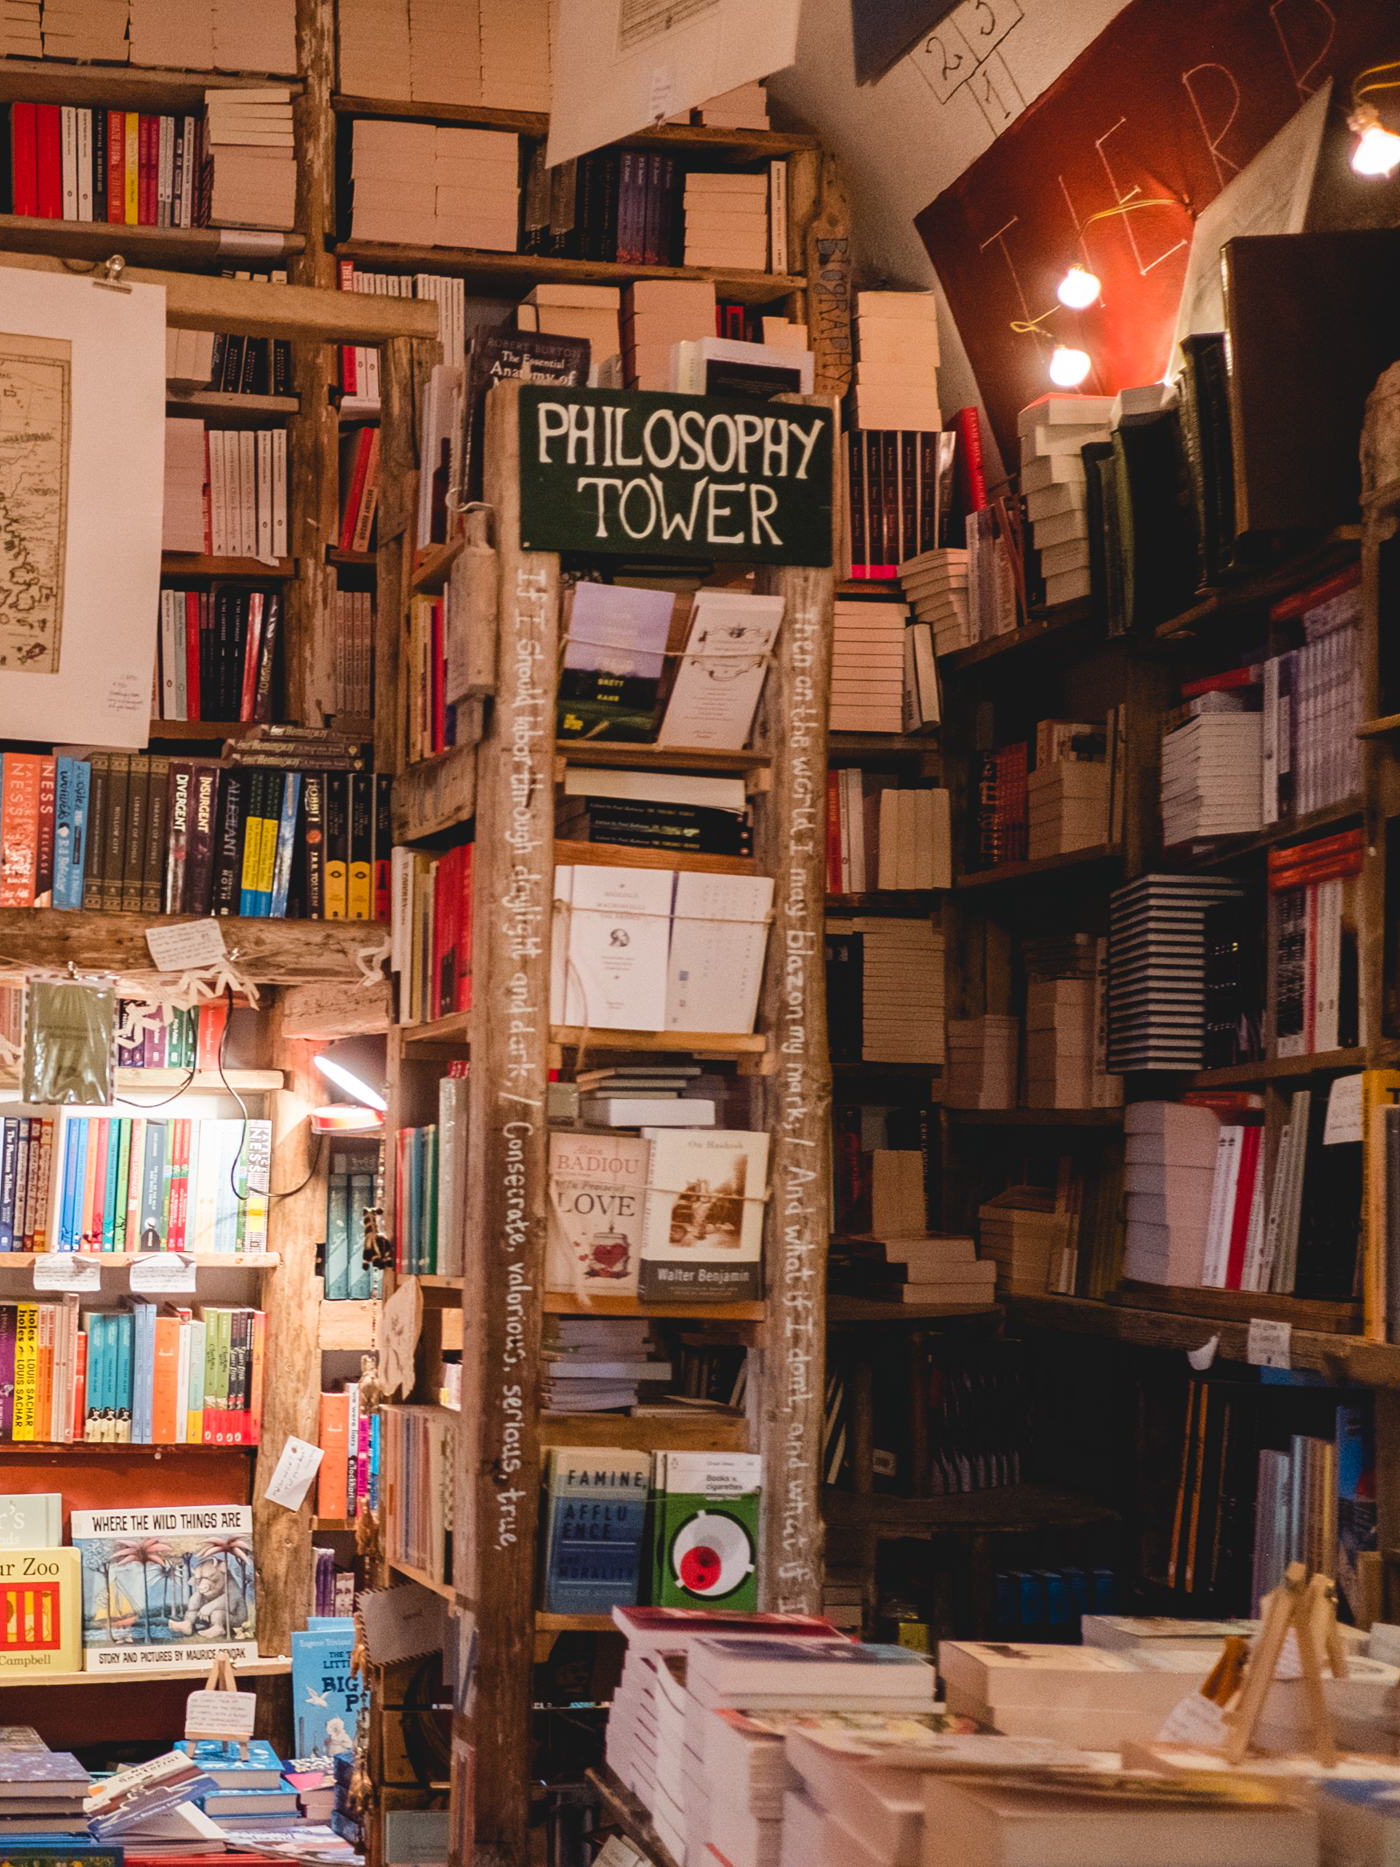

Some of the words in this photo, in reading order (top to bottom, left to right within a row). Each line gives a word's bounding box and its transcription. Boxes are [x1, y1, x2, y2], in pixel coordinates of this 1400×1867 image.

[502, 350, 520, 364] The
[522, 353, 565, 370] Essential
[537, 402, 825, 479] PHILOSOPHY
[577, 473, 783, 546] TOWER
[517, 568, 547, 604] If
[9, 763, 25, 816] NESS
[173, 774, 190, 833] DIVERGENT
[198, 776, 213, 834] INSURGENT
[504, 773, 545, 855] through
[40, 826, 48, 875] RELEASE
[221, 869, 230, 901] ROTH
[784, 867, 810, 918] may
[502, 865, 543, 961] daylight
[785, 930, 816, 1021] blazon
[557, 1154, 640, 1175] BADIOU
[557, 1192, 636, 1217] LOVE
[784, 1225, 817, 1284] what
[657, 1267, 694, 1283] Walter
[698, 1268, 750, 1284] Benjamin
[17, 1308, 28, 1342] holes
[28, 1308, 37, 1342] holes
[16, 1359, 26, 1385] LOUIS
[27, 1358, 36, 1385] LOUIS
[14, 1388, 24, 1427] SACHAR
[25, 1388, 36, 1427] SACHAR
[567, 1469, 647, 1490] FAMINE,
[705, 1482, 743, 1492] cigarettes
[92, 1516, 128, 1532] WHERE
[130, 1515, 149, 1531] THE
[152, 1514, 177, 1531] WILD
[180, 1513, 218, 1530] THINGS
[220, 1511, 242, 1528] ARE
[564, 1504, 629, 1522] AFFLU
[22, 1556, 60, 1576] Zoo
[98, 1653, 121, 1665] STORY
[122, 1652, 138, 1663] AND
[140, 1651, 173, 1663] PICTURES
[174, 1650, 184, 1661] BY
[185, 1649, 216, 1660] MAURICE
[321, 1676, 359, 1693] BIG
